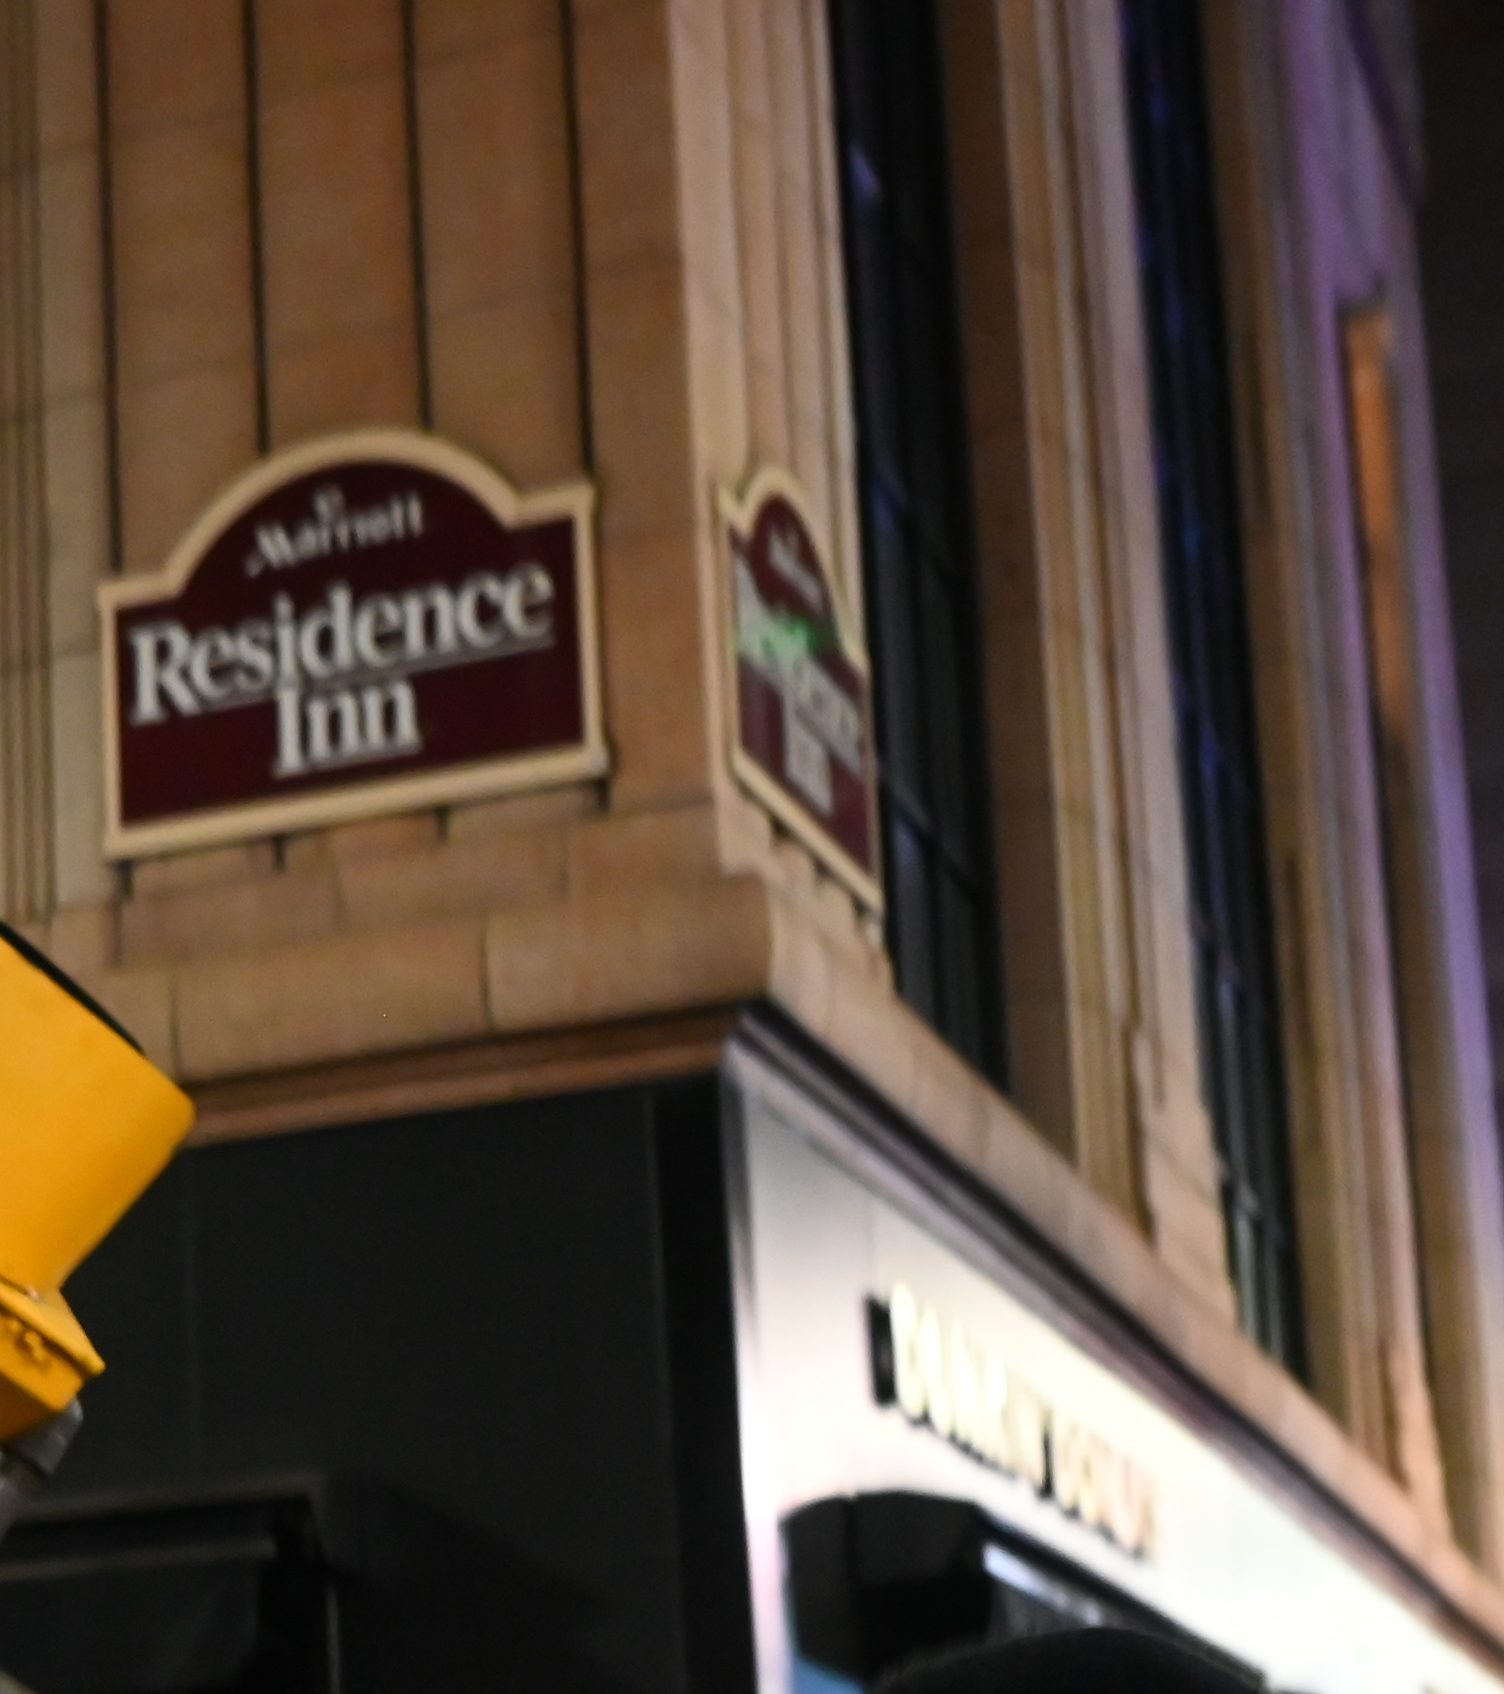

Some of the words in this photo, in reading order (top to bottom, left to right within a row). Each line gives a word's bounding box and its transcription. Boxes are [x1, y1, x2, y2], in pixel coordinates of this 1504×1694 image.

[244, 492, 424, 578] Marriott
[127, 562, 554, 726] Residence
[274, 677, 424, 778] Inn
